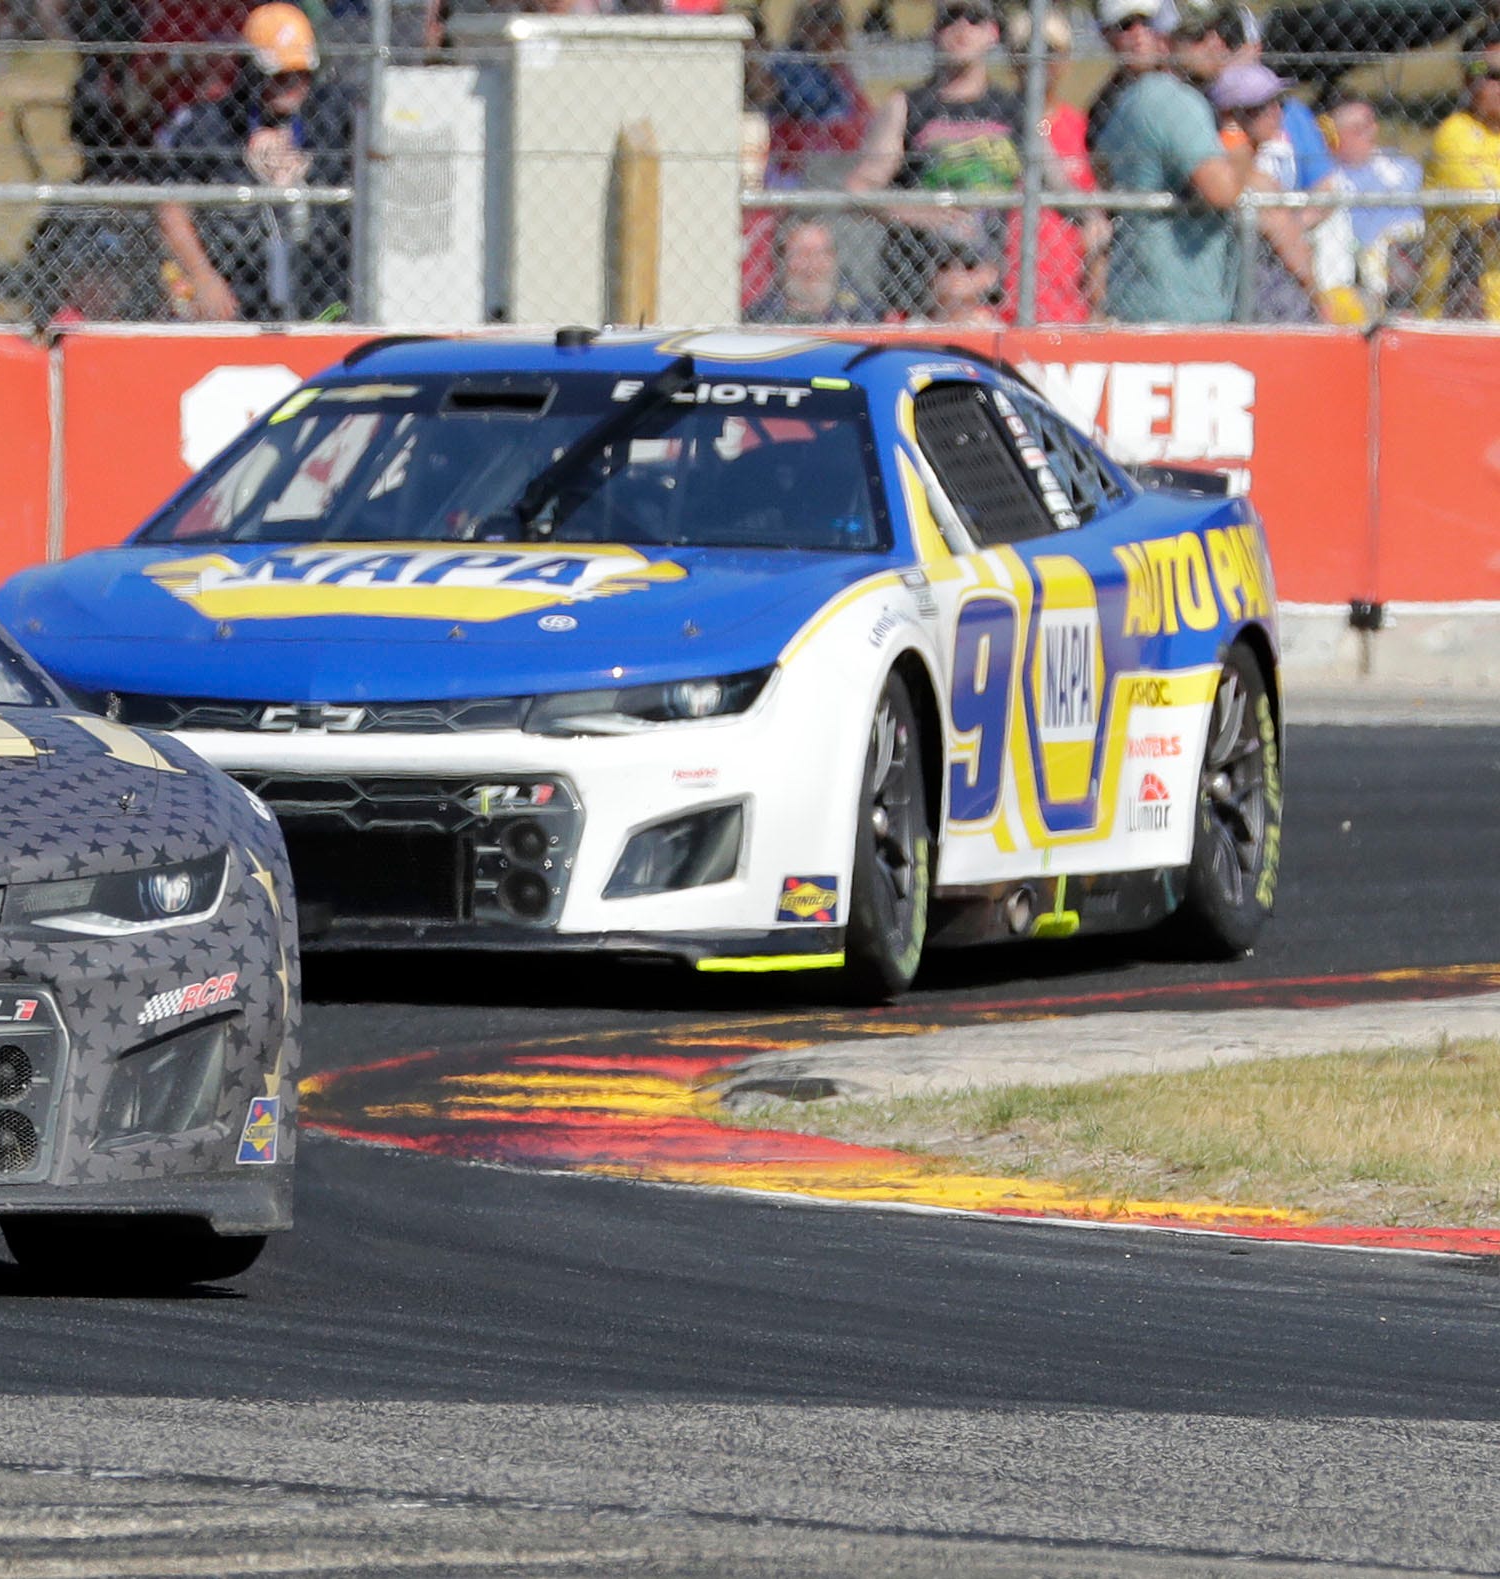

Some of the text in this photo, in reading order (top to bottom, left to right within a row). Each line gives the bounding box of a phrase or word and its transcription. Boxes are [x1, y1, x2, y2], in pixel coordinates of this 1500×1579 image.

[610, 379, 813, 408] ELIOTT
[230, 551, 596, 586] NAPA
[1112, 531, 1220, 638] AUTO
[949, 596, 1015, 821] 9
[1045, 624, 1094, 728] NAPA
[179, 971, 238, 1013] RCR
